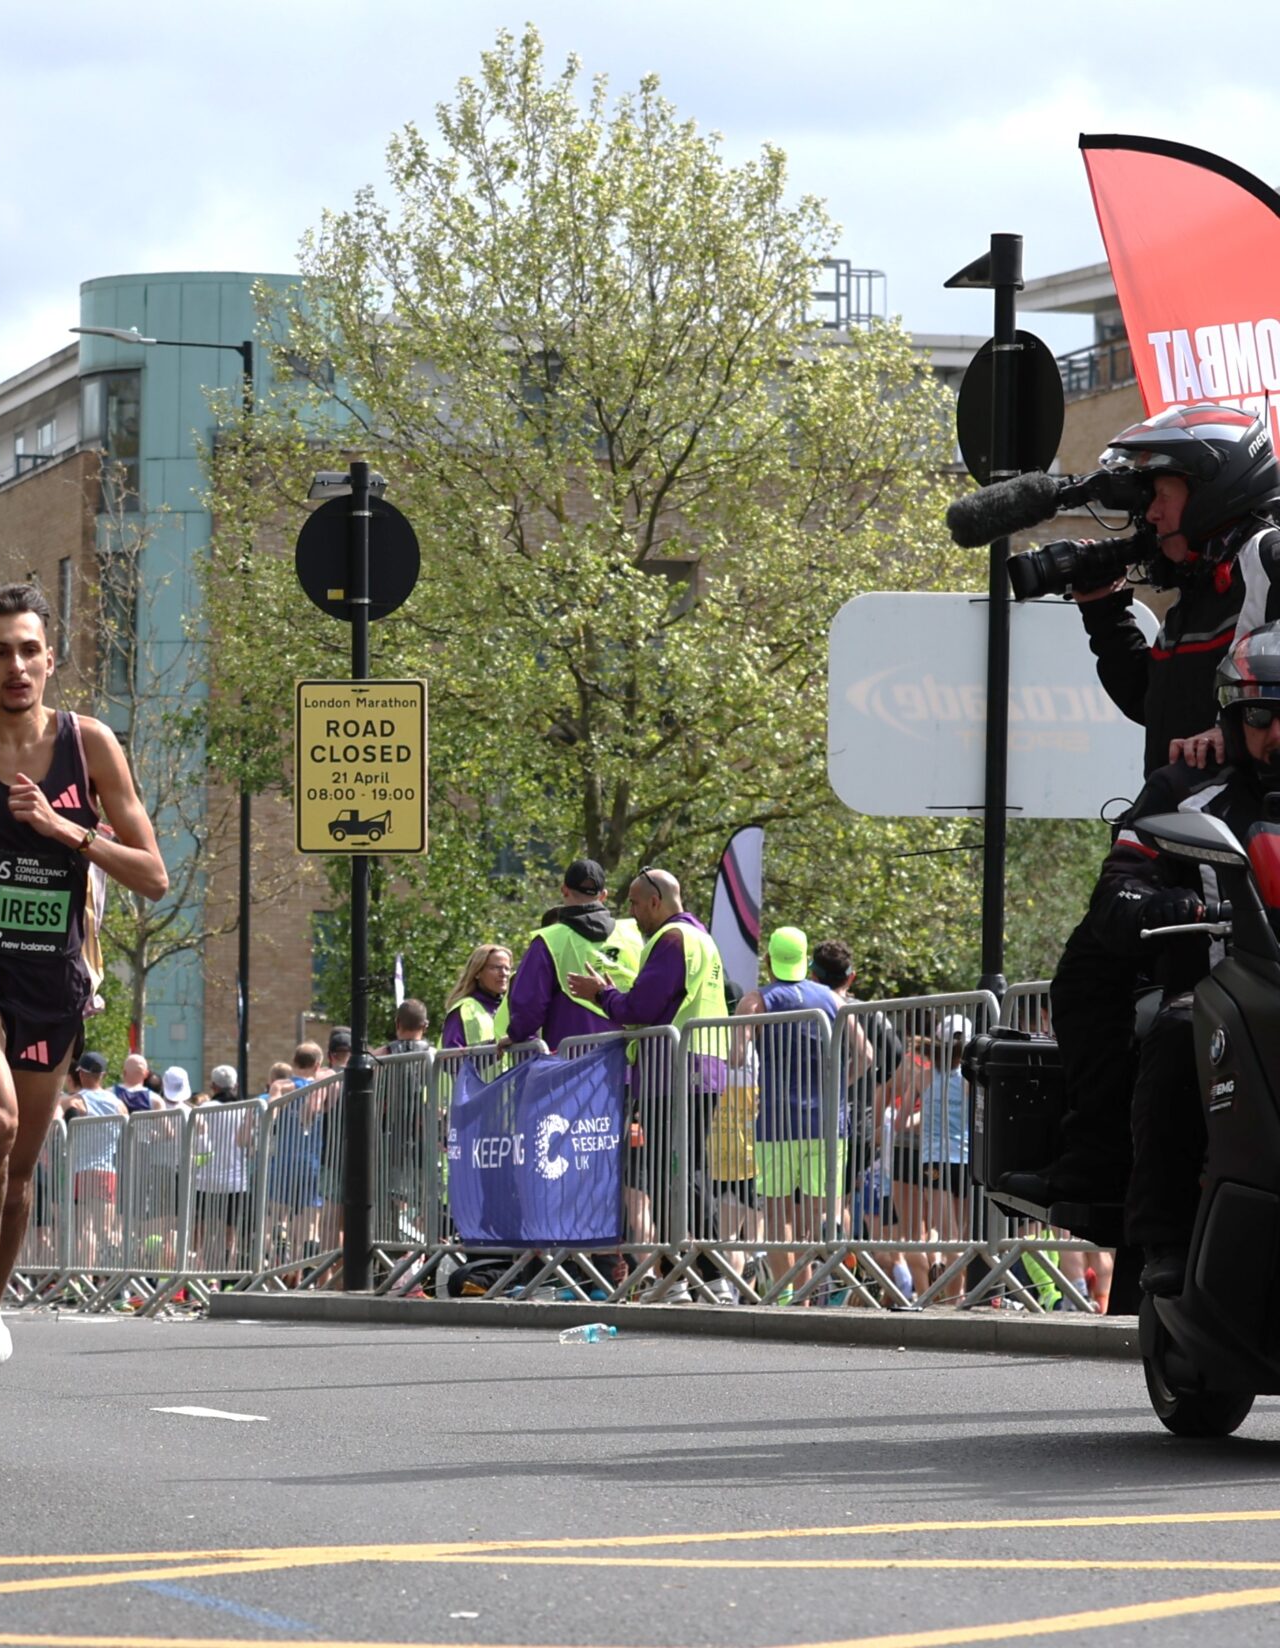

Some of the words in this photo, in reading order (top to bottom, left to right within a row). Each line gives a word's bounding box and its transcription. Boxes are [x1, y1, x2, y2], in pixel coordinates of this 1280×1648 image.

[304, 697, 351, 709] London
[356, 697, 417, 709] Marathon
[326, 719, 396, 738] ROAD
[310, 745, 412, 763] CLOSED
[331, 771, 348, 784] 21
[353, 771, 390, 786] April
[307, 788, 356, 801] 08:00
[372, 788, 415, 801] 19:00
[16, 857, 39, 866] TATA
[15, 866, 68, 878] CONSULTANCY
[14, 873, 49, 885] SERVICES
[1, 940, 20, 950] new
[21, 941, 56, 953] balance
